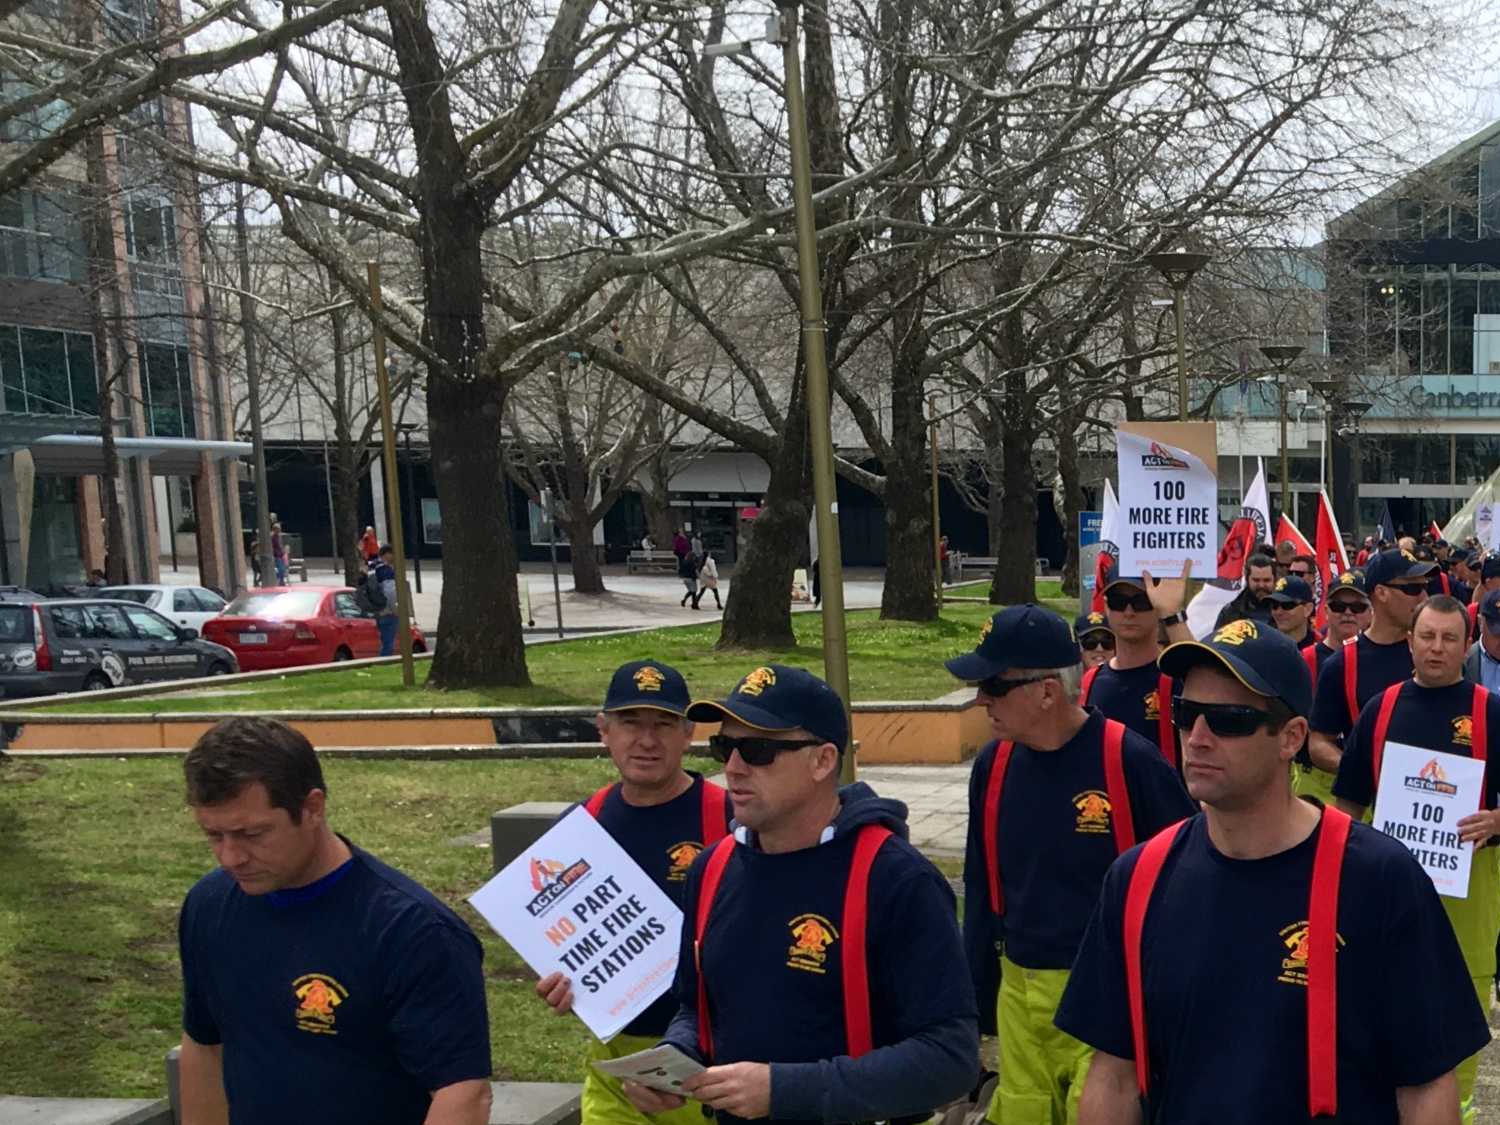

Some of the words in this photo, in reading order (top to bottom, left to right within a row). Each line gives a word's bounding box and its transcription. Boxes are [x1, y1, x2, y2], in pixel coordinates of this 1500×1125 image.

[1153, 480, 1185, 500] 100
[1129, 507, 1172, 525] MORE
[1177, 507, 1209, 525] FIRE
[1133, 531, 1206, 549] FIGHTERS
[1406, 778, 1425, 789] ACT
[1412, 802, 1444, 824] 100
[1383, 820, 1429, 844] MORE
[531, 889, 553, 914] ACT
[544, 916, 577, 947] NO
[572, 875, 623, 924] PART
[558, 928, 608, 973] TIME
[601, 894, 647, 937] FIRE
[581, 916, 666, 994] STATIONS
